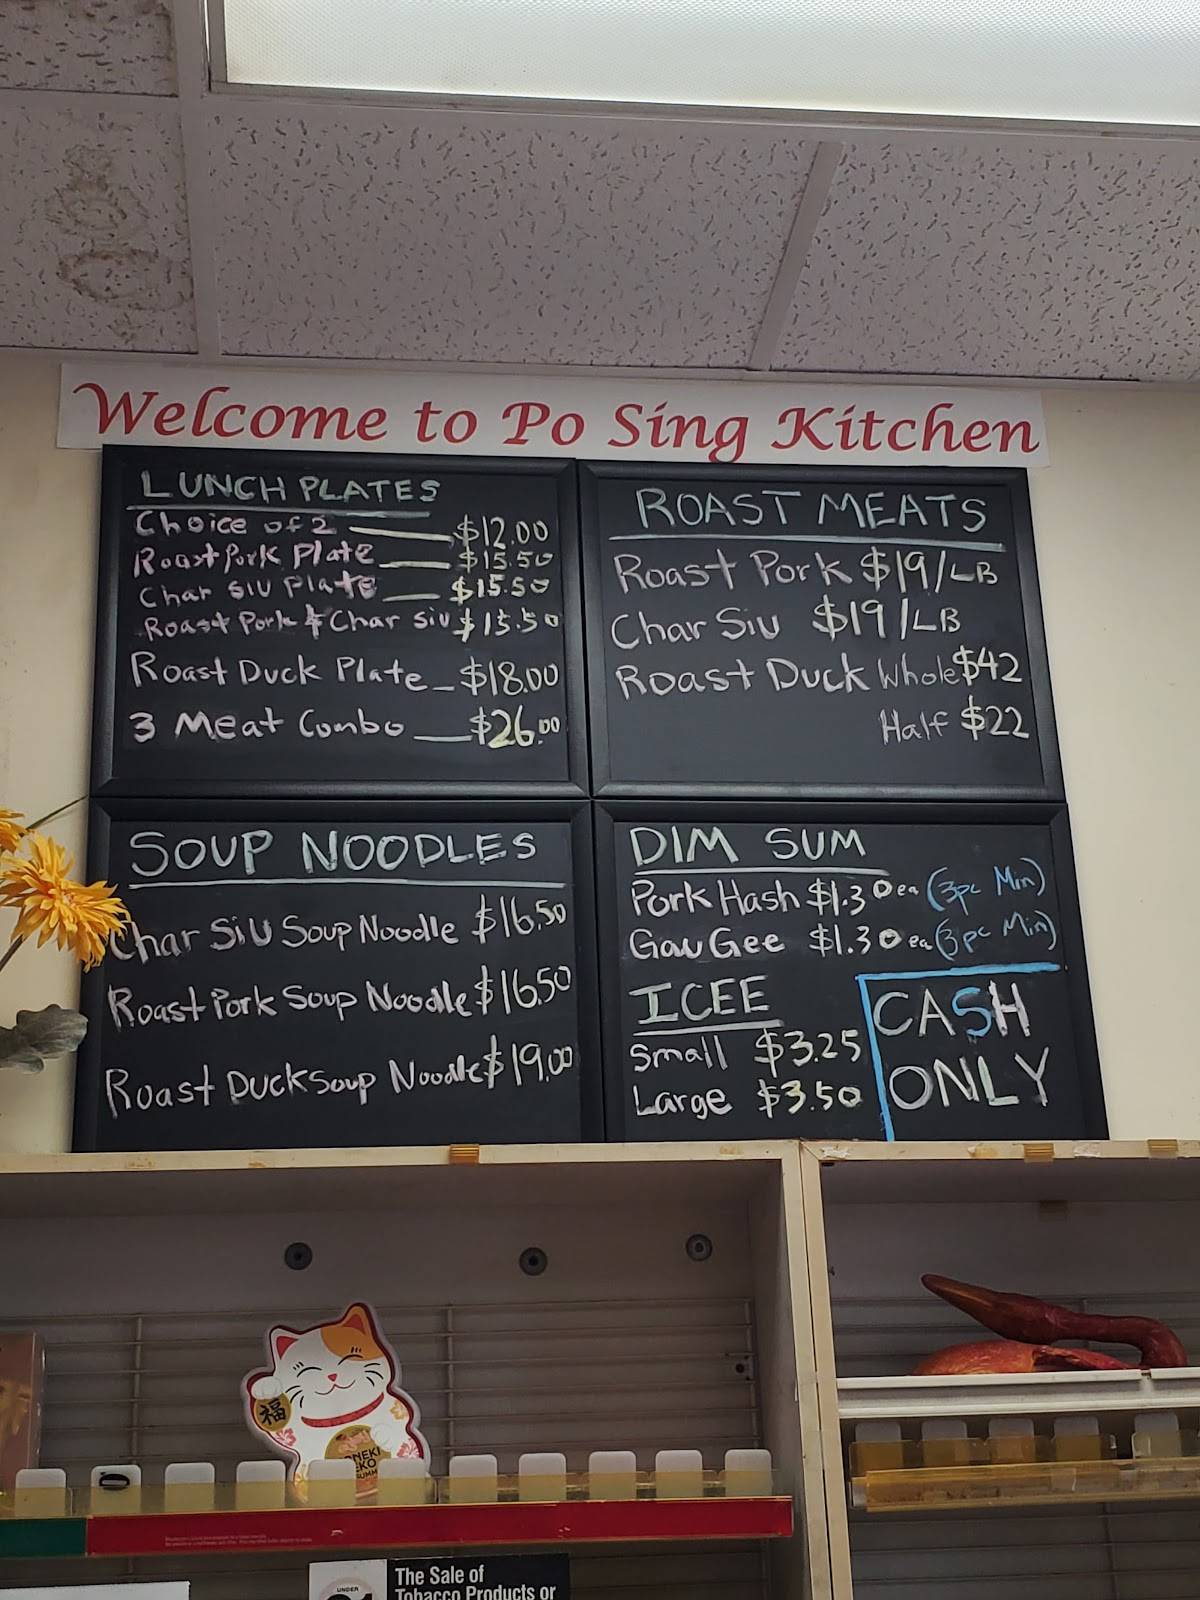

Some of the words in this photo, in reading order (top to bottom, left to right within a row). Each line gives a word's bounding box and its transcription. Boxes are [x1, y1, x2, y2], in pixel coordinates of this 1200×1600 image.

[74, 383, 387, 440] Welcome
[416, 402, 477, 442] to
[504, 402, 586, 446] Po
[608, 402, 749, 464] Sing
[771, 403, 1040, 454] Kitchen
[141, 471, 285, 503] LUNCH
[300, 476, 440, 502] PLATES
[636, 487, 800, 529] ROAST
[818, 492, 987, 532] MEATS
[136, 511, 247, 536] Choice
[264, 516, 302, 533] of
[311, 515, 337, 535] 2
[452, 514, 549, 549] $12.00
[134, 542, 219, 578] Roast
[224, 542, 281, 574] Pork
[294, 540, 375, 569] Plate
[458, 545, 553, 573] $15.50
[614, 549, 736, 593] Roast
[750, 550, 852, 587] Pork
[862, 546, 998, 595] $19/LB
[139, 585, 212, 609] Char
[283, 570, 377, 599] Plate
[449, 574, 550, 605] $15.50
[144, 612, 230, 641] Roast
[238, 609, 298, 635] Pork
[330, 608, 400, 632] Char
[452, 607, 560, 643] $15.50
[611, 612, 706, 650] Char
[131, 652, 228, 687] Roast
[239, 655, 321, 686] Duck
[336, 657, 428, 691] Plate
[459, 656, 559, 697] $18.00
[615, 658, 755, 700] Roast
[766, 652, 870, 693] Duck
[952, 646, 1023, 687] $42
[129, 714, 154, 741] 3
[175, 708, 283, 741] Meat
[299, 709, 405, 737] Combo
[471, 705, 561, 750] $26.00
[879, 709, 950, 745] Half
[960, 695, 1031, 740] $22
[129, 829, 274, 877] SOUP
[302, 830, 537, 874] NOODLES
[630, 827, 738, 866] DIM
[765, 827, 866, 862] SUM
[632, 880, 712, 918] Pork
[718, 879, 800, 917] Hash
[806, 877, 893, 916] $1.30
[109, 920, 200, 965] Char
[281, 914, 352, 952] Soup
[358, 915, 460, 946] Noodle
[471, 894, 566, 945] $16.50
[709, 927, 786, 957] Gee
[808, 923, 902, 958] $1.30
[108, 984, 206, 1032] Roast
[210, 984, 279, 1021] Pork
[282, 985, 358, 1022] Soup
[366, 979, 475, 1018] Noodle
[475, 964, 573, 1017] $16.50
[629, 975, 770, 1026] ICEE
[872, 979, 1031, 1038] CASH
[629, 1034, 727, 1072] Small
[754, 1028, 862, 1079] $3.25
[105, 1064, 217, 1121] Roast
[388, 1054, 483, 1095] Noodle
[481, 1034, 575, 1091] $19.00
[888, 1046, 1051, 1110] ONLY
[631, 1085, 734, 1121] Large
[757, 1080, 862, 1120] $3.50
[259, 1398, 288, 1427] 福
[395, 1565, 425, 1586] The
[429, 1564, 465, 1585] Sale
[469, 1564, 485, 1583] of
[395, 1586, 461, 1600] Tobacco
[466, 1584, 536, 1600] Products
[540, 1585, 556, 1600] or
